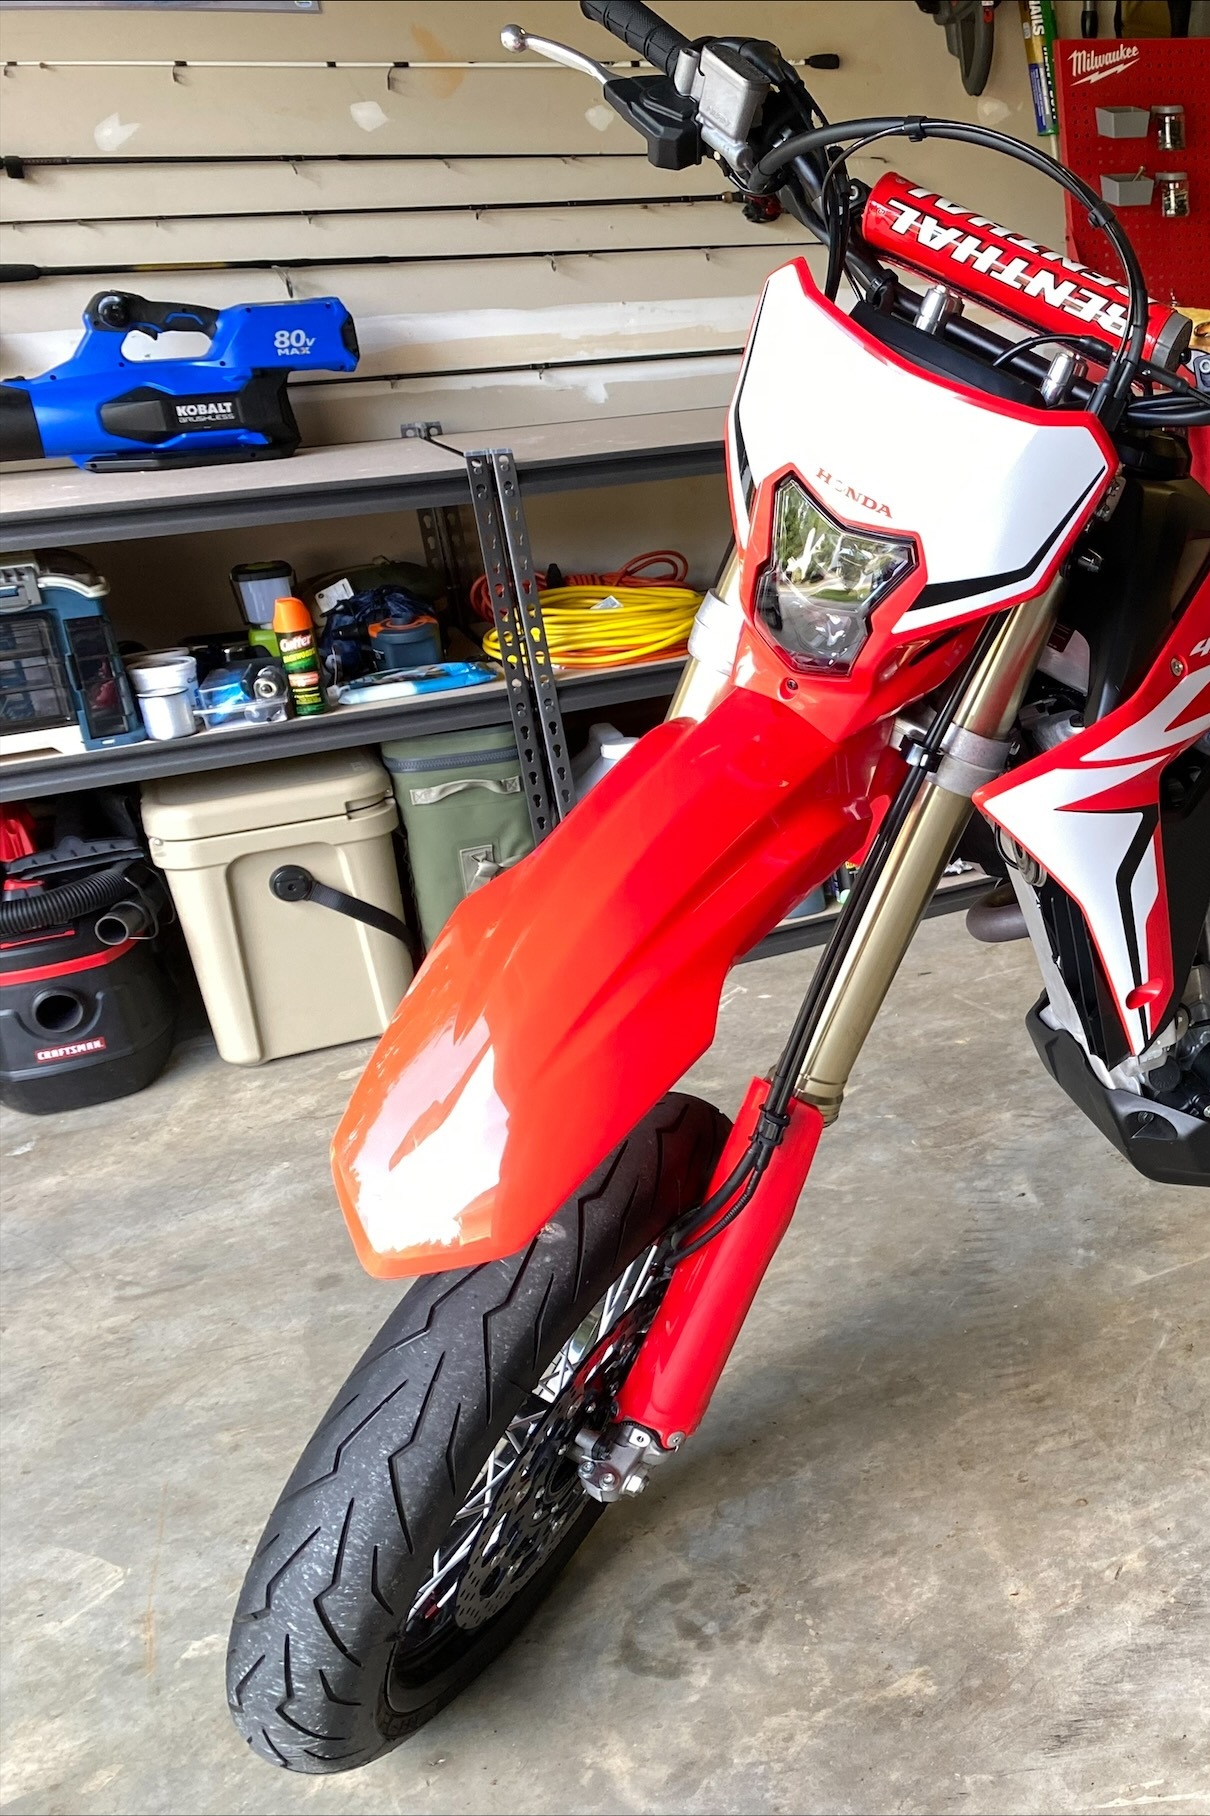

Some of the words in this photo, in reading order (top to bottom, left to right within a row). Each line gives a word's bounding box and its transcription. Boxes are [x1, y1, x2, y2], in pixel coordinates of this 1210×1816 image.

[1067, 44, 1140, 77] Milwaukee
[888, 199, 1134, 339] RENTHAL
[278, 346, 311, 356] MAX
[176, 402, 233, 417] KOBALT
[178, 413, 235, 423] BRUSHLESS
[816, 467, 893, 519] HONDA
[37, 1039, 101, 1061] CRAFTSMAN
